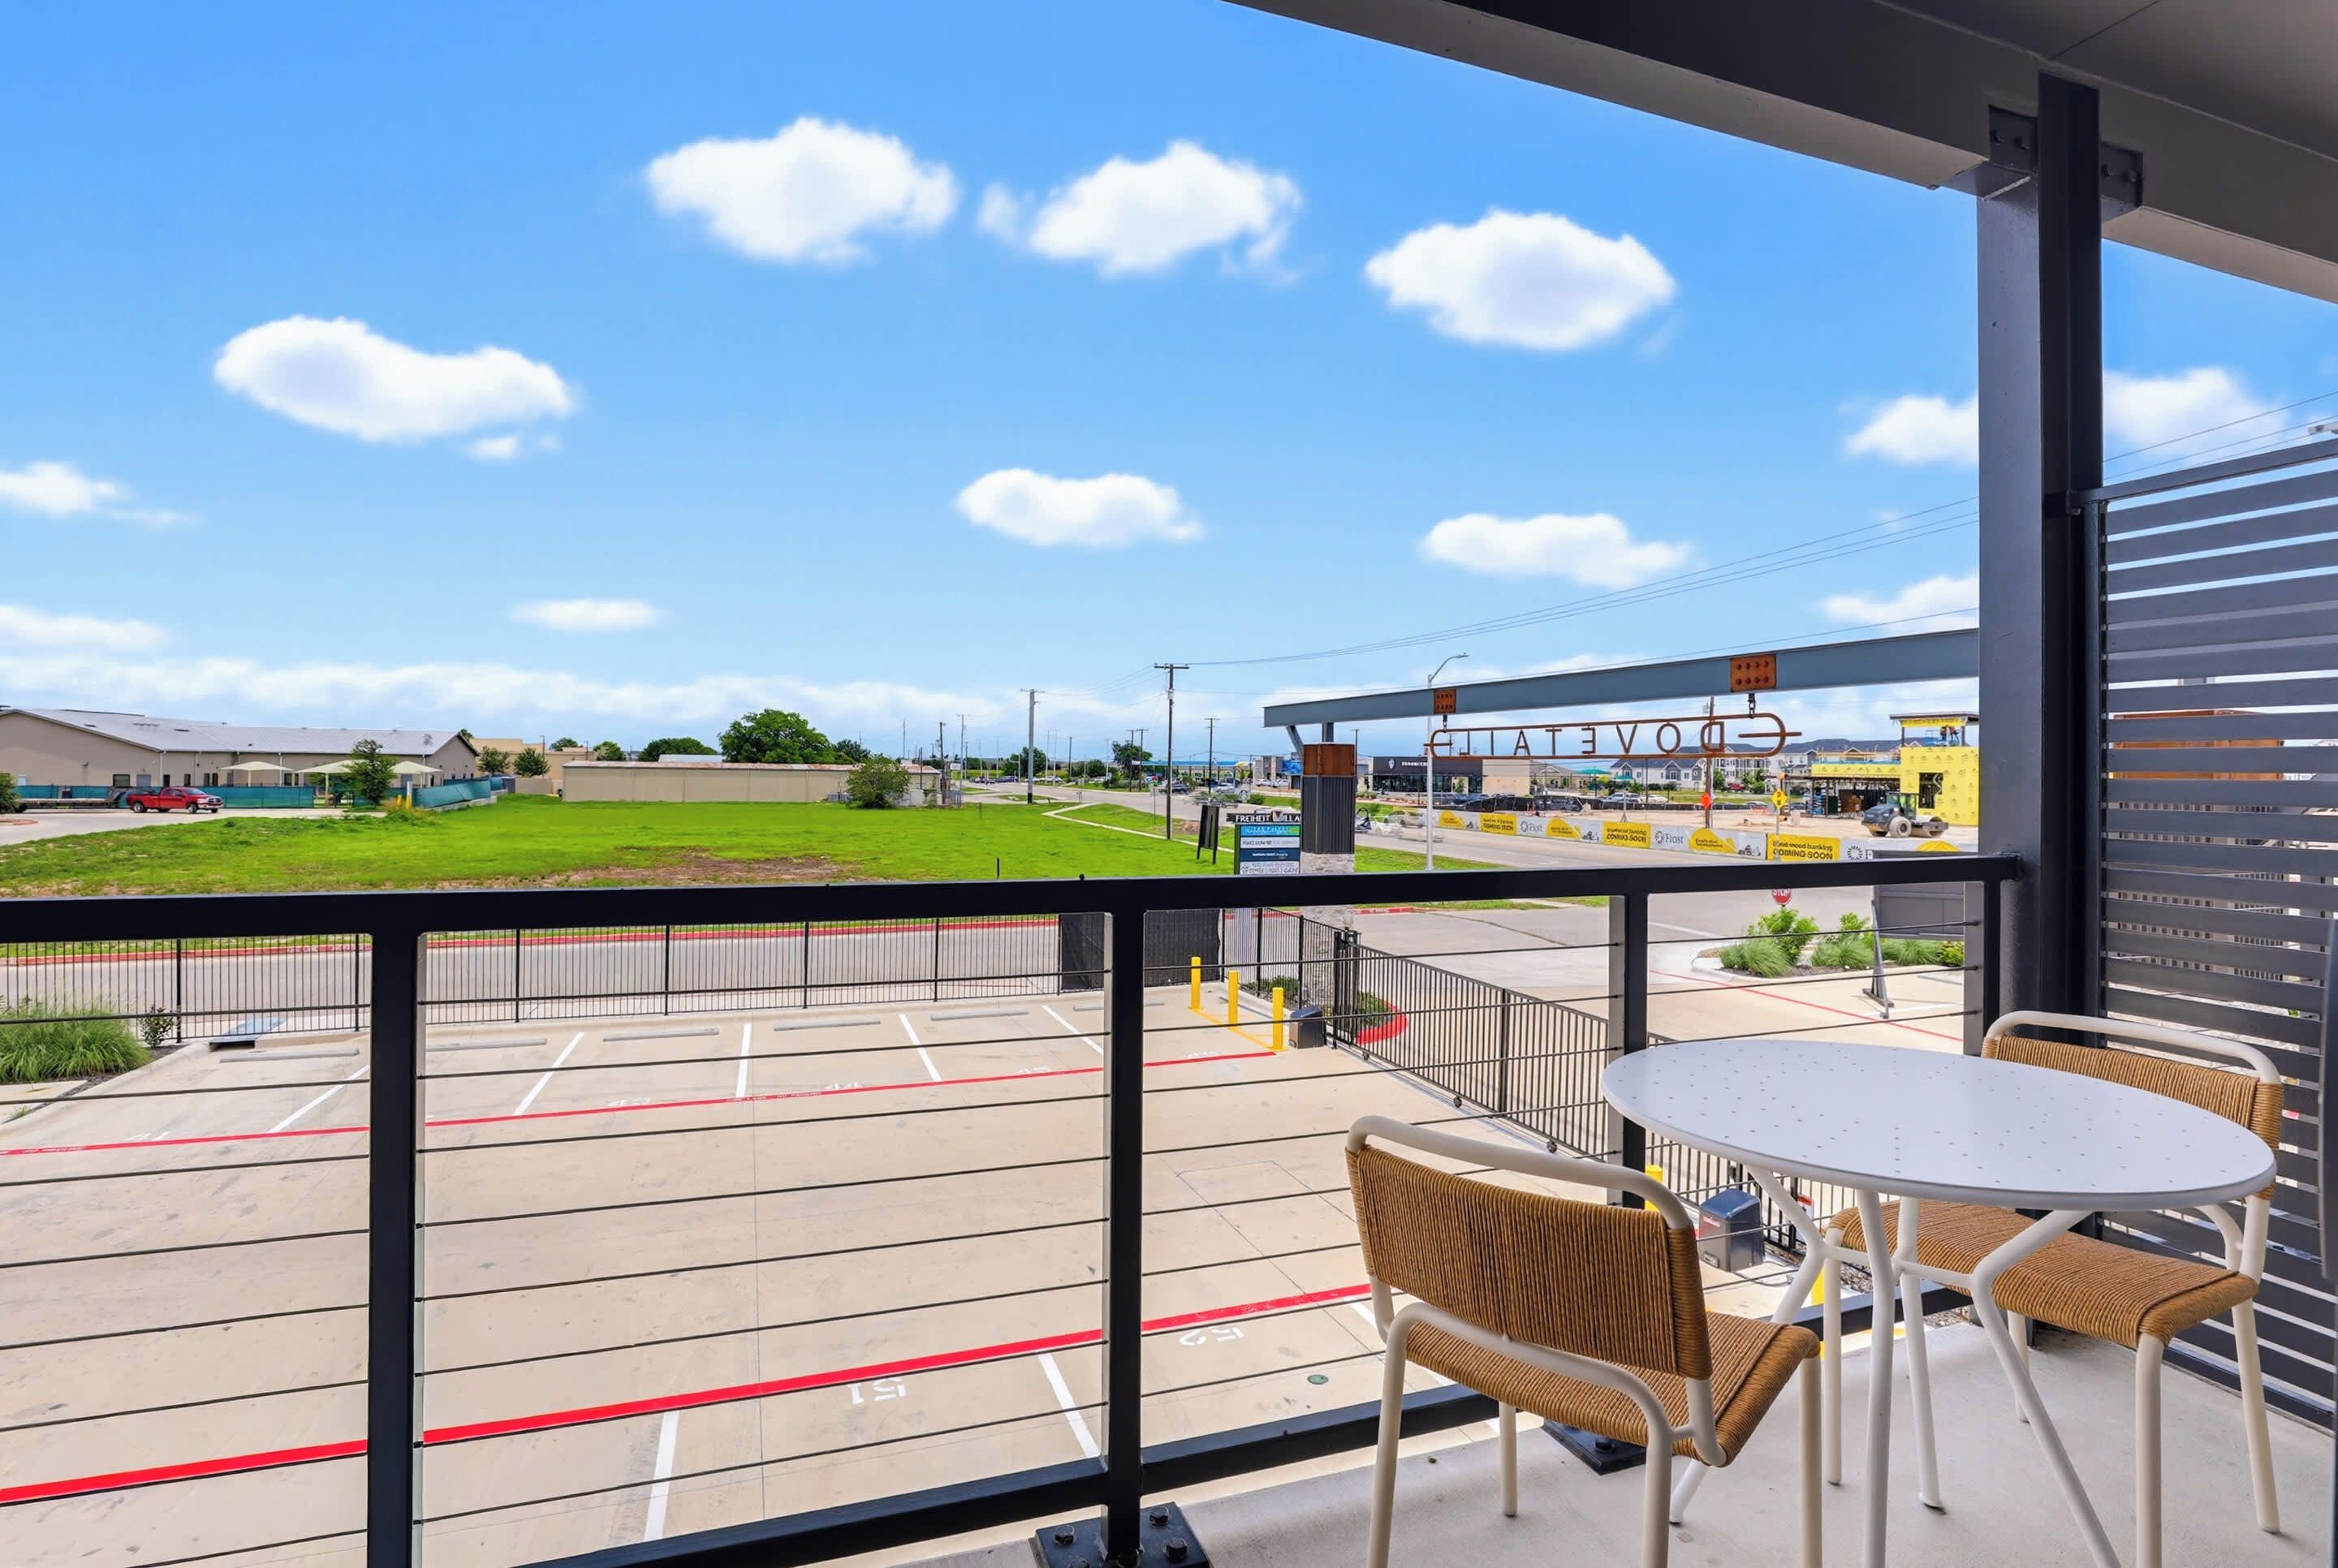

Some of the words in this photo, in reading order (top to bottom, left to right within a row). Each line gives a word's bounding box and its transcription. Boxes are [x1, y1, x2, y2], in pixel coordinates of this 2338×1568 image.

[1235, 814, 1270, 822] FREIHEIT
[1272, 811, 1301, 822] VILLA
[1665, 834, 1684, 844] Frost
[1807, 842, 1832, 852] banking
[1773, 849, 1806, 858] COMING
[1807, 851, 1832, 859] SOON
[848, 1376, 907, 1404] 51
